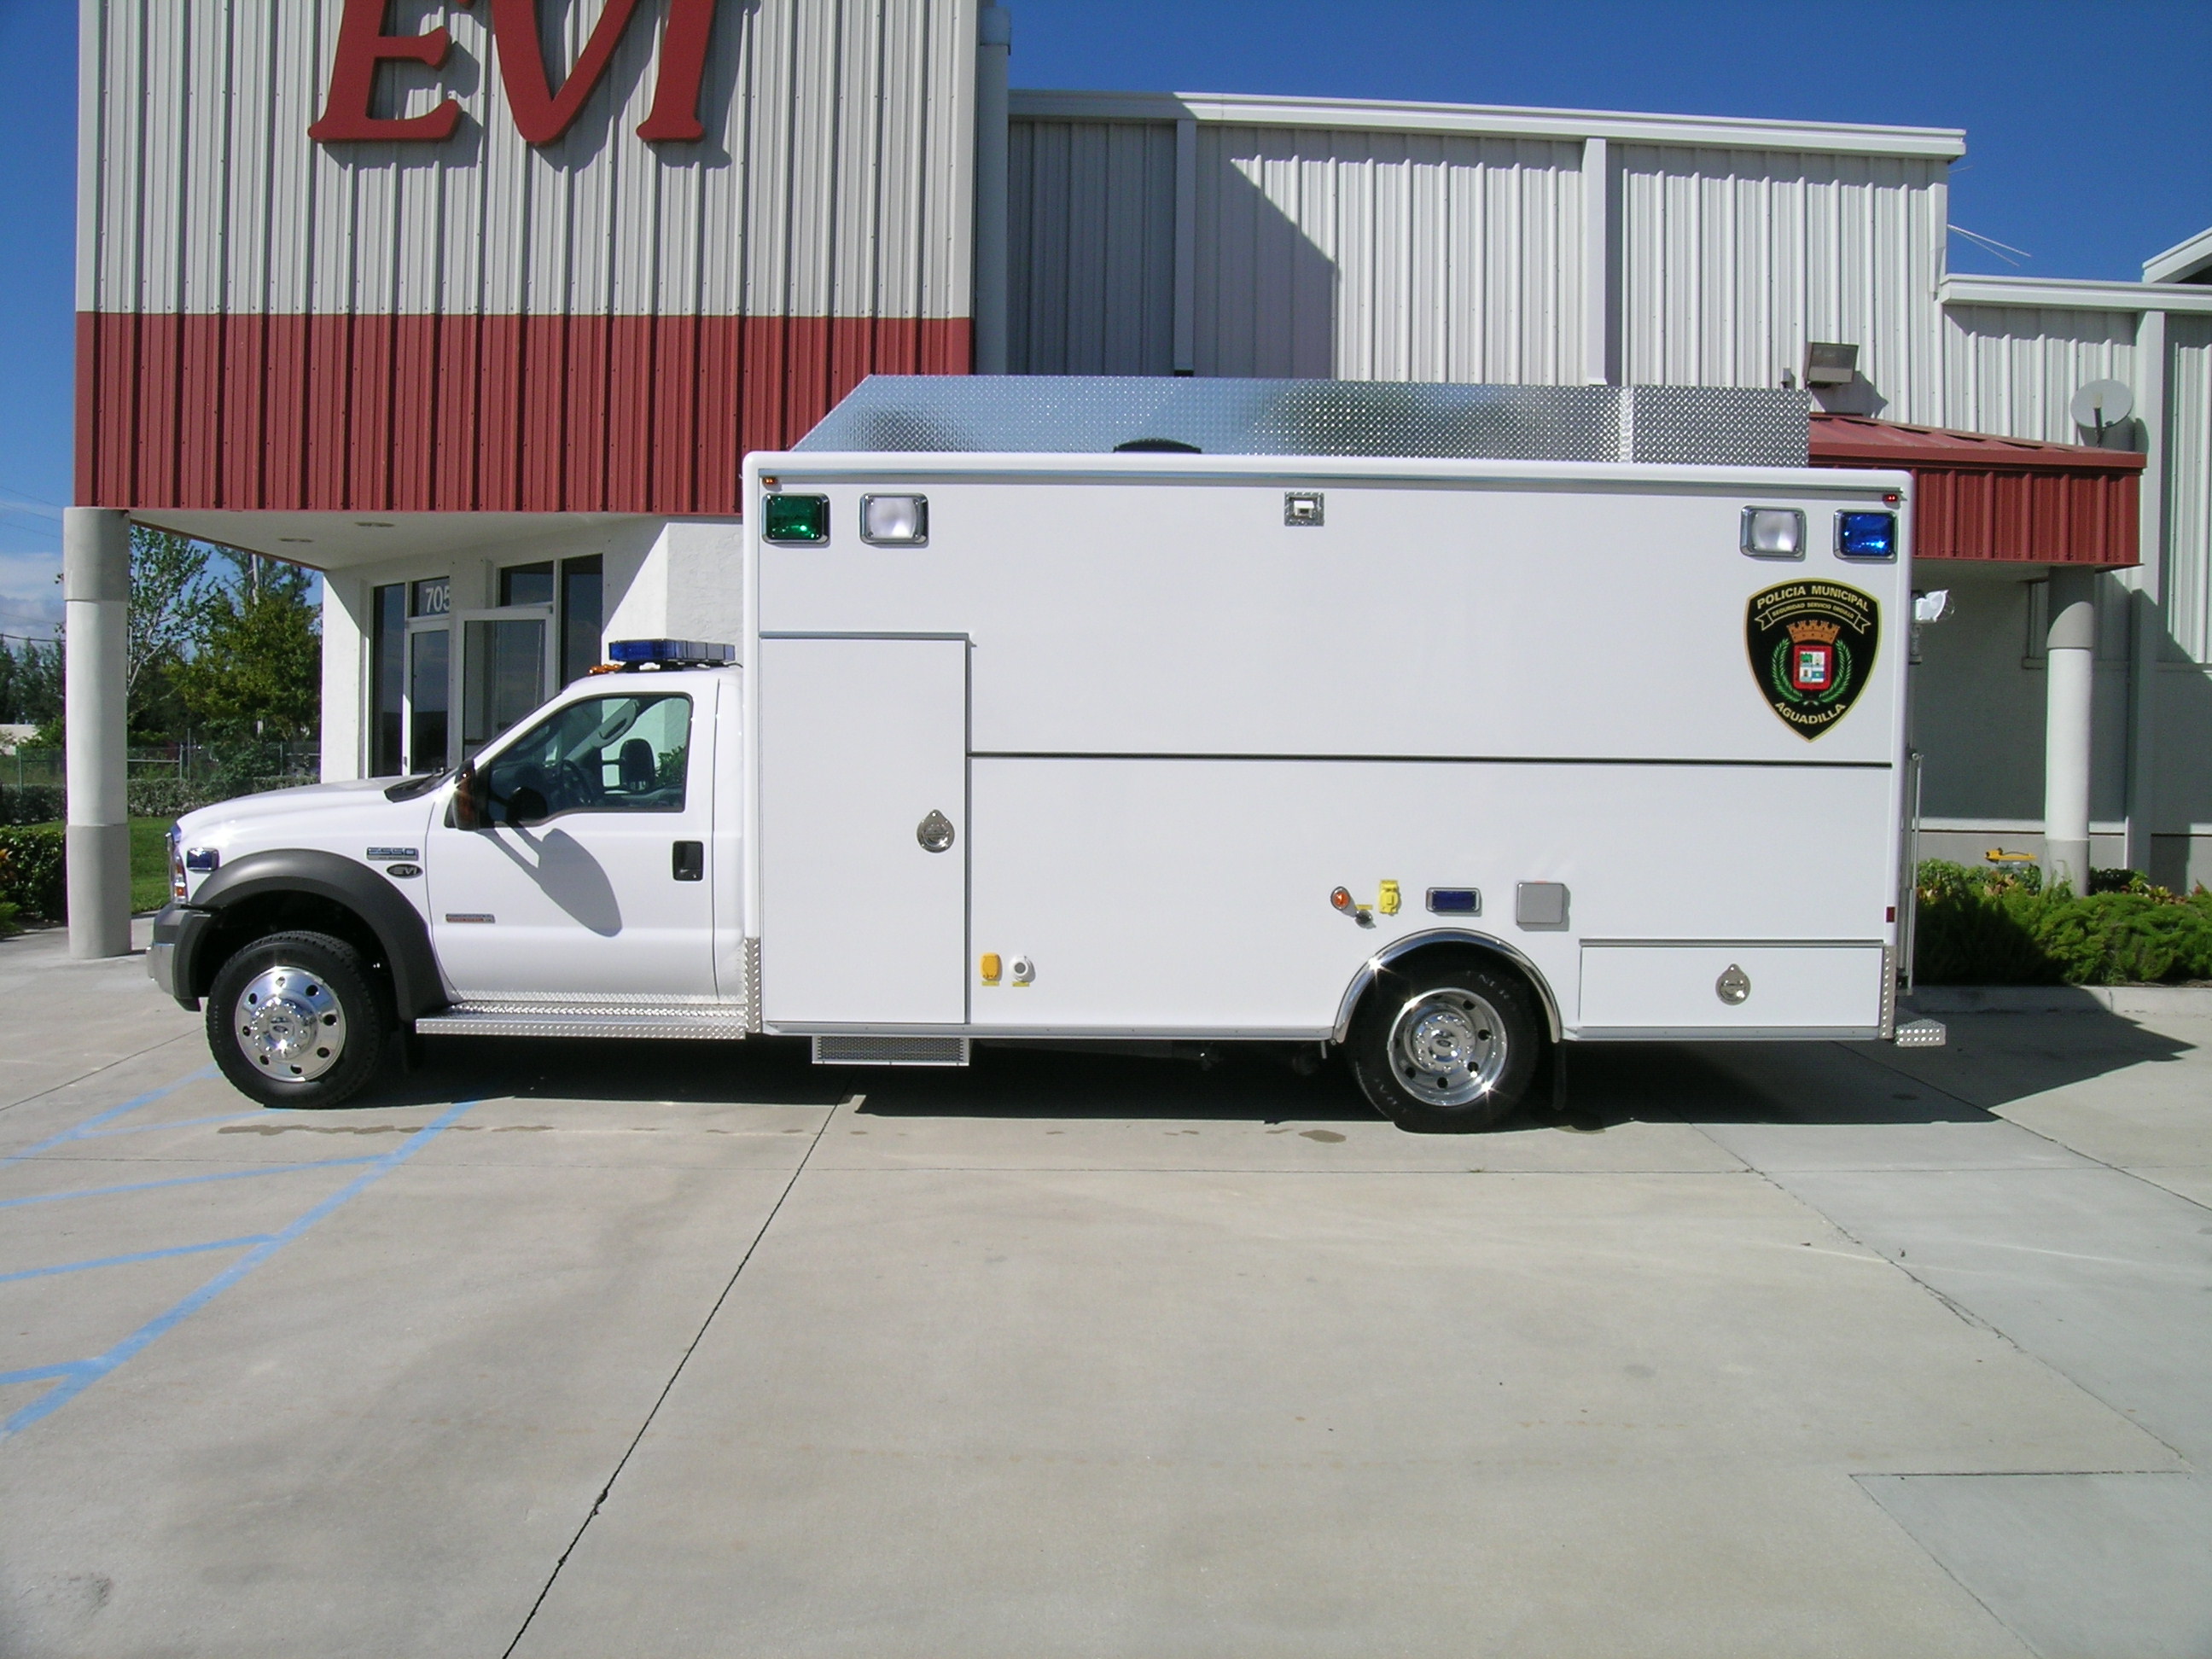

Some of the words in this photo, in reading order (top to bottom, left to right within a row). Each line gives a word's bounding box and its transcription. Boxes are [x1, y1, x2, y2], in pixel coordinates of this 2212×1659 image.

[308, 0, 715, 144] EVI
[425, 585, 451, 613] 705
[1756, 585, 1807, 609] POLICIA
[1811, 585, 1869, 612] MUNICIPAL
[1775, 701, 1846, 724] AGUADILLA
